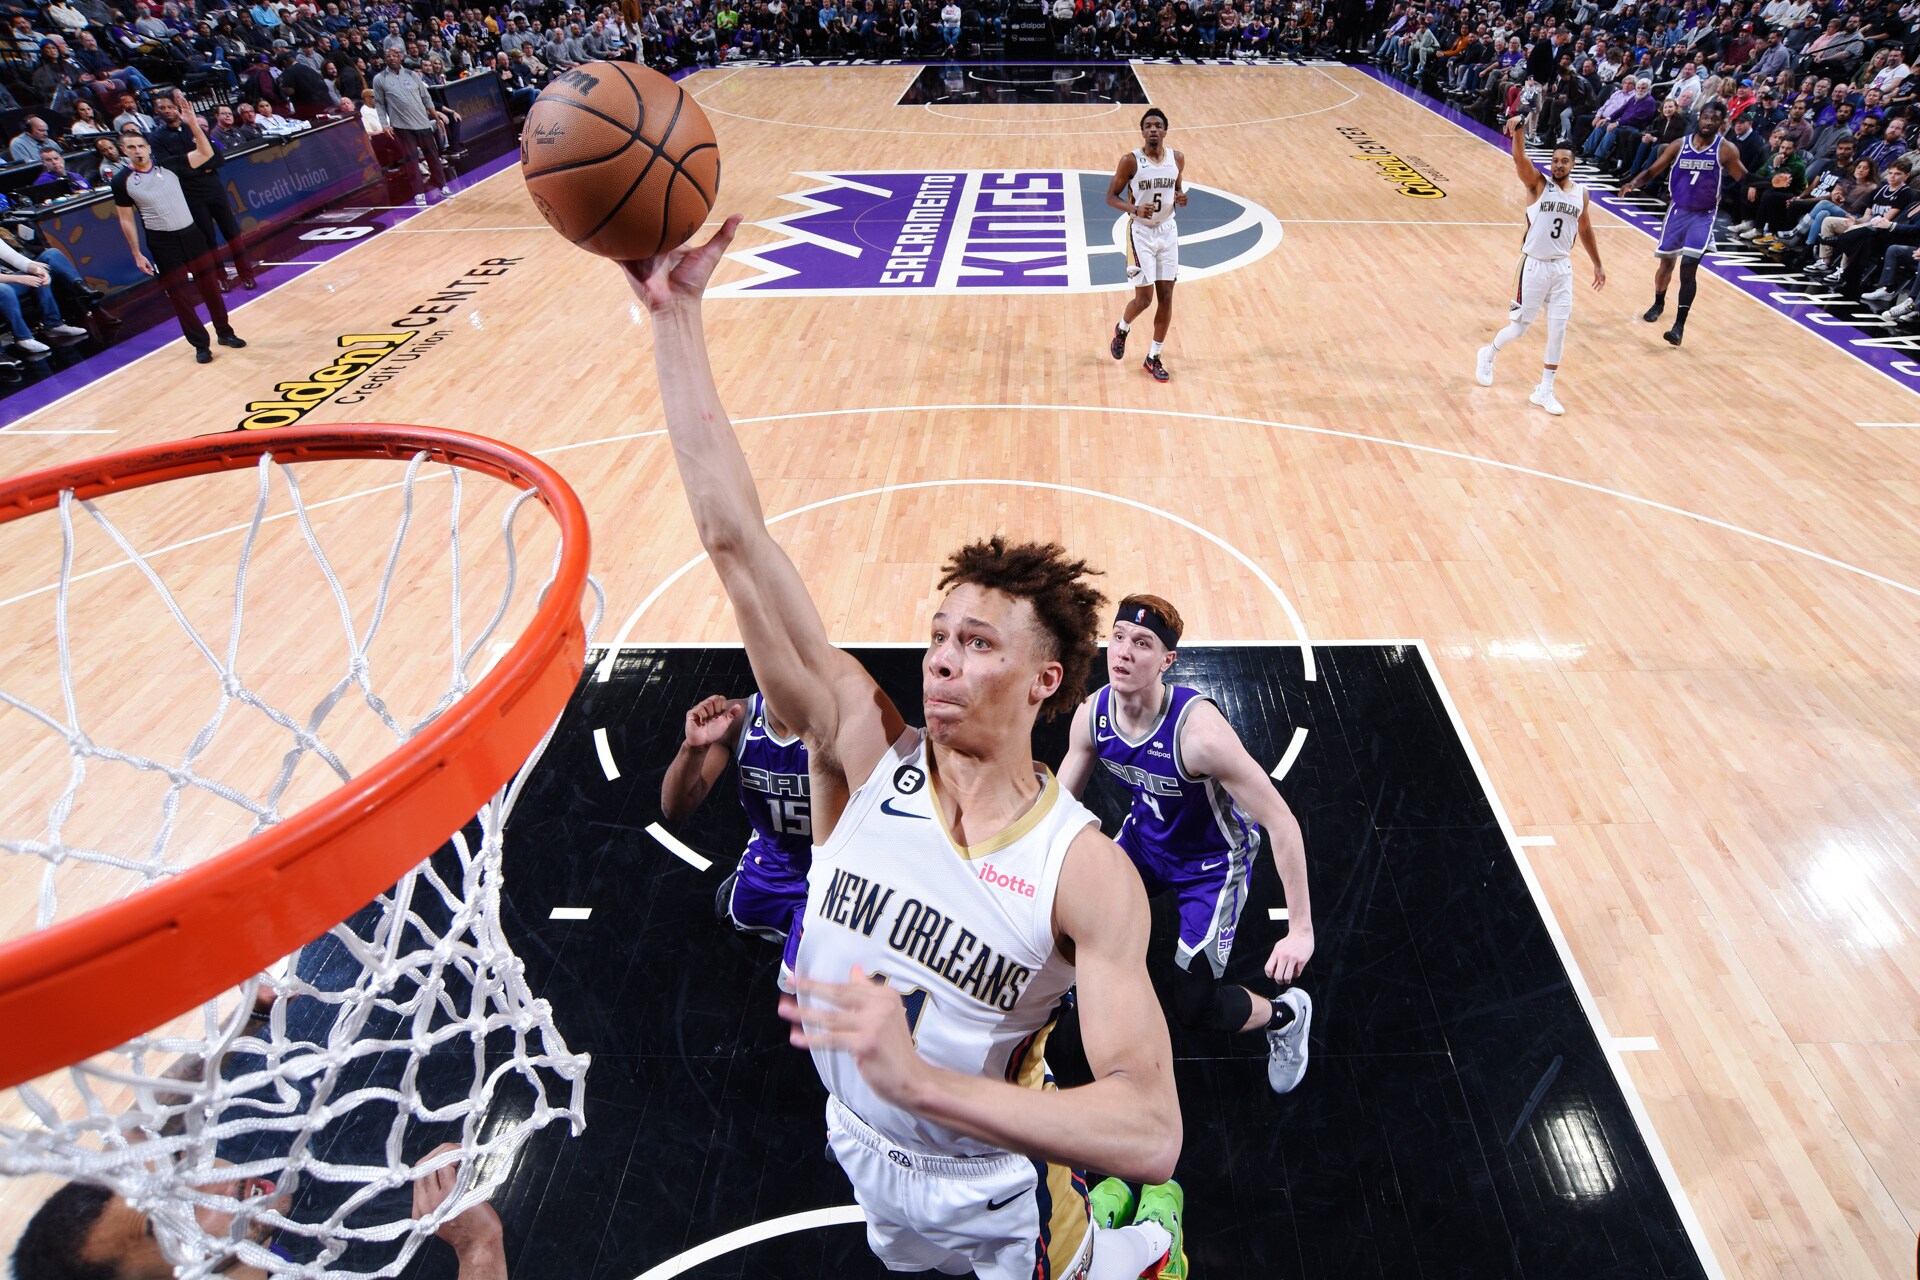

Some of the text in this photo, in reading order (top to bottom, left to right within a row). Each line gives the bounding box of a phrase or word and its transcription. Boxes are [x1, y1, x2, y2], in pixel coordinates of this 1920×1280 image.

[1021, 22, 1046, 30] dialpad
[1336, 127, 1392, 154] CENTER
[1679, 159, 1715, 170] SAC
[1690, 171, 1700, 185] 7
[248, 180, 292, 209] Credit
[291, 167, 329, 191] Union
[1138, 177, 1175, 191] NEW ORLEAN
[1153, 193, 1162, 213] 5
[1540, 201, 1581, 218] NEW ORLEAN
[879, 175, 956, 284] SACRAMENTO
[956, 172, 1069, 287] KINGS
[1550, 218, 1563, 239] 3
[391, 257, 525, 328] CENTER
[238, 330, 420, 431] olden1
[334, 330, 453, 404] Credit Union
[754, 716, 763, 728] 6
[1099, 715, 1108, 728] 6
[1147, 749, 1171, 759] dialpad
[740, 766, 811, 797] SA
[897, 769, 921, 793] 6
[1100, 757, 1183, 797] SAC
[767, 799, 812, 836] 15
[978, 862, 1036, 898] ibotta
[818, 867, 896, 938] NEW
[888, 898, 1030, 1013] ORLEANS
